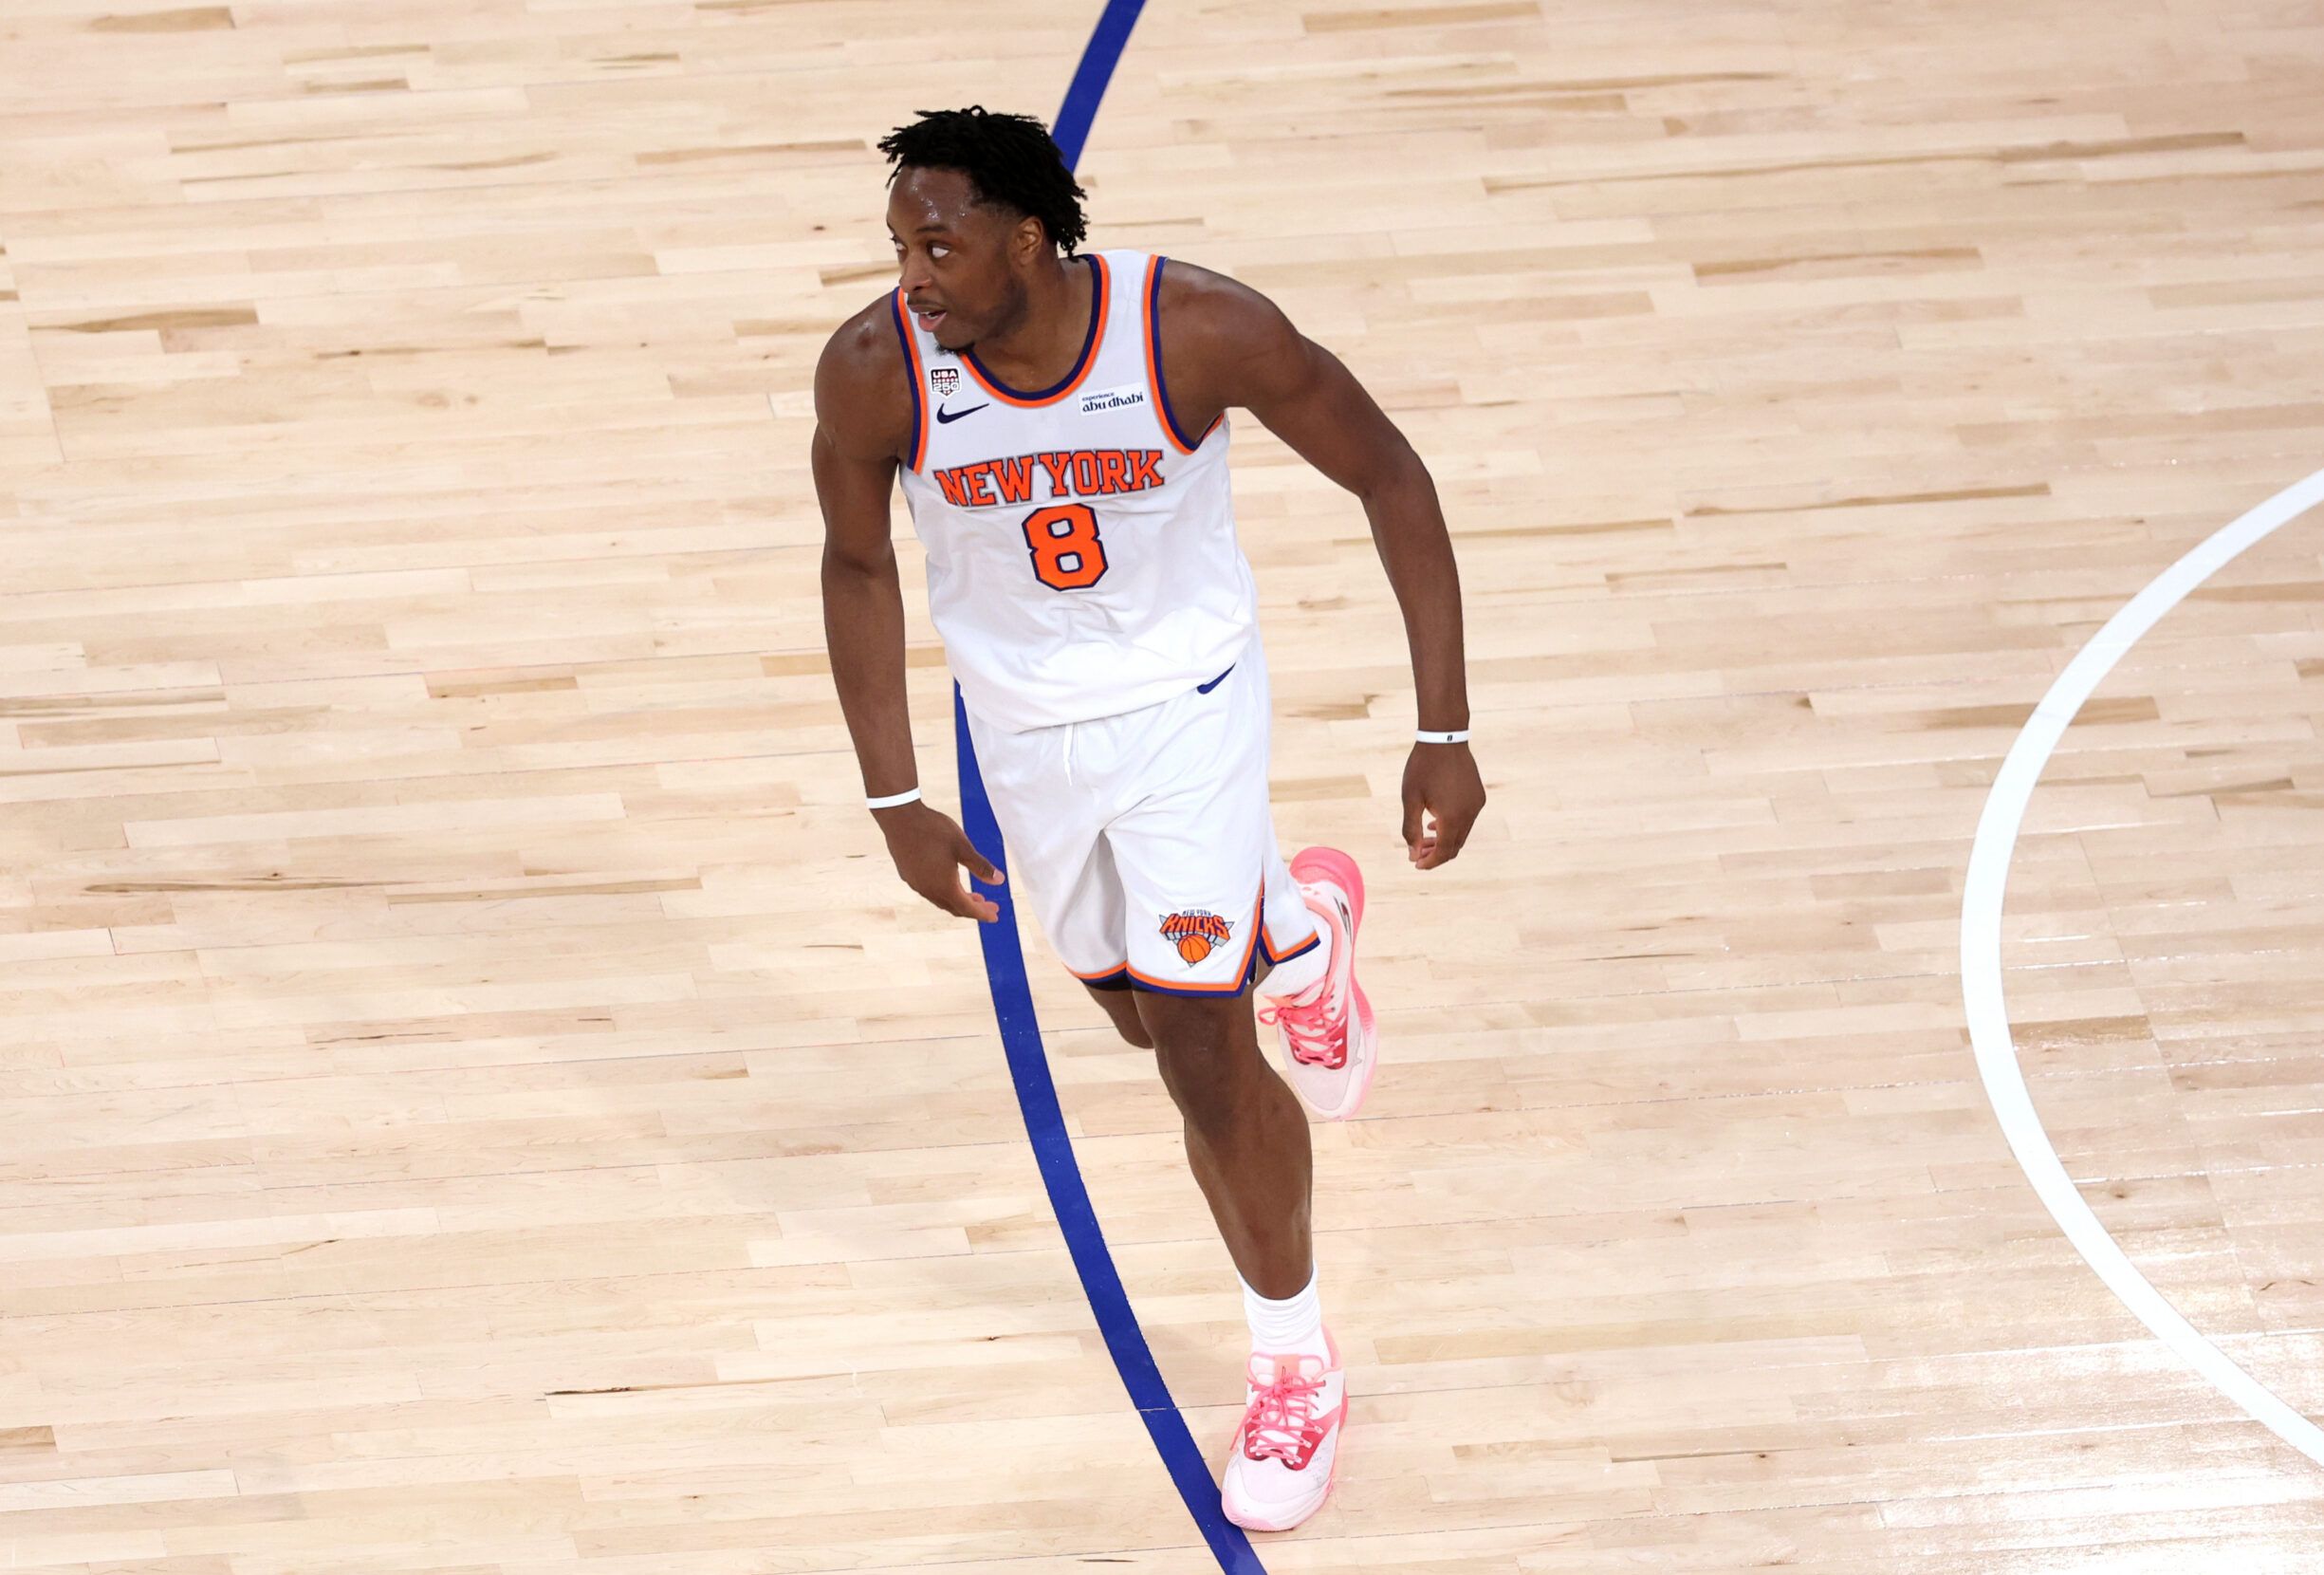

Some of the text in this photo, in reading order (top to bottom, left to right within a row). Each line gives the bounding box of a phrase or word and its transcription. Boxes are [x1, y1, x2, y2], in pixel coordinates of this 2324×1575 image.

[932, 370, 957, 379] USA
[933, 382, 959, 391] 250
[1081, 392, 1115, 401] experience
[1082, 392, 1144, 413] abu dhabi
[933, 449, 1165, 507] NEW YORK
[1022, 503, 1109, 592] 8
[1159, 913, 1231, 942] KNICKS
